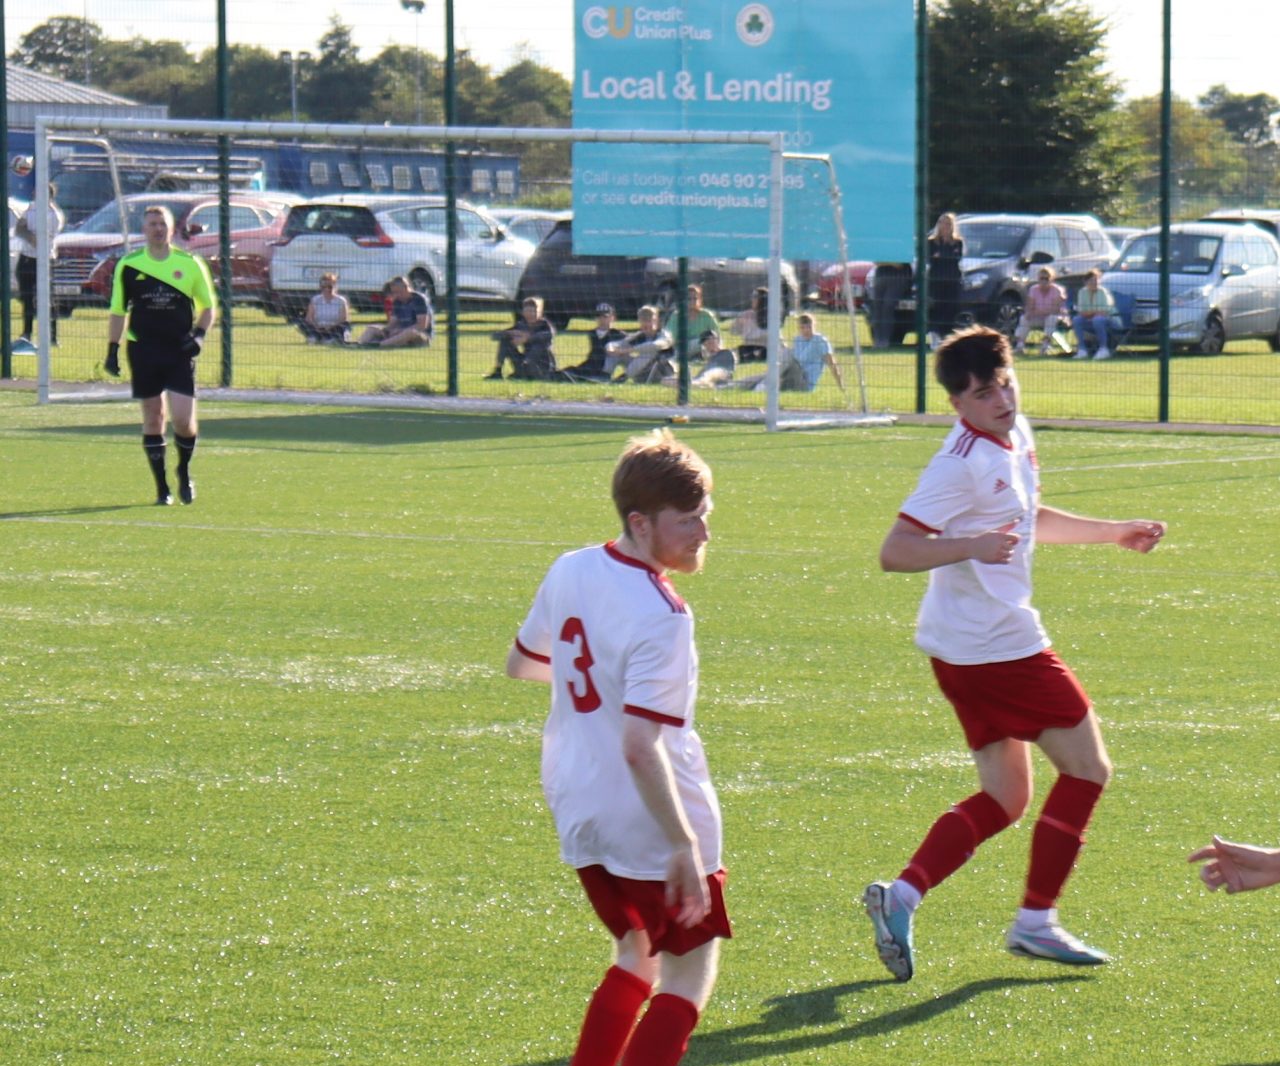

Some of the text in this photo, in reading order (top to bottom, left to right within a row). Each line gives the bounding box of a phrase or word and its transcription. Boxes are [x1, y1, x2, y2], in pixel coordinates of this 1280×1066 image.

[582, 6, 632, 39] CU
[635, 7, 684, 21] Credit
[582, 70, 832, 110] Local & Lending
[582, 170, 609, 186] Call
[612, 174, 630, 186] us
[633, 173, 675, 190] today
[678, 175, 697, 188] on
[700, 173, 731, 188] 046
[734, 173, 755, 188] 90
[582, 190, 769, 210] or see creditunionplus.ie
[560, 617, 602, 713] 3
